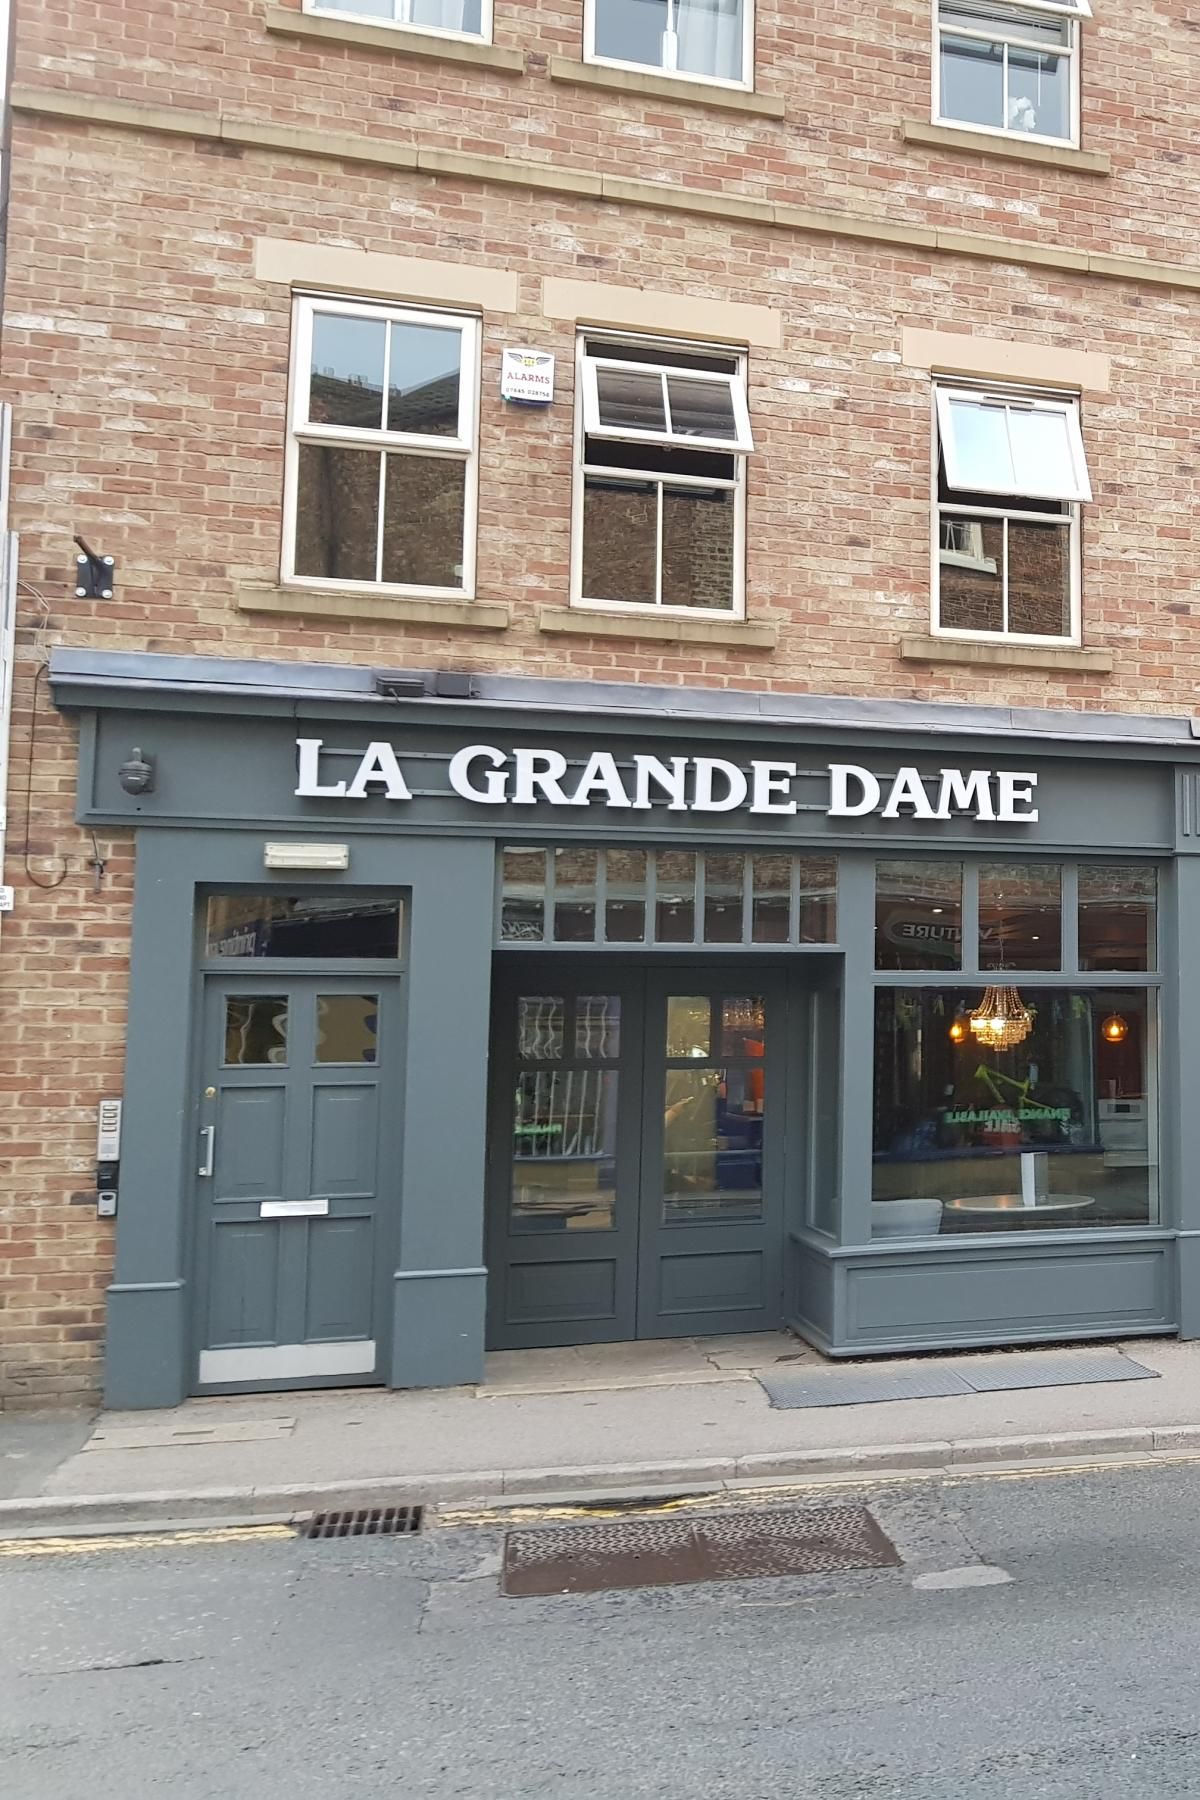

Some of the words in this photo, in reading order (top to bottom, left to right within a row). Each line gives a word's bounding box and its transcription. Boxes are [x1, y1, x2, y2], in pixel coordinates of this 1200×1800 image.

[507, 371, 551, 385] ALARMS
[294, 738, 413, 800] LA
[448, 745, 797, 815] GRANDE
[828, 763, 1039, 823] DAME
